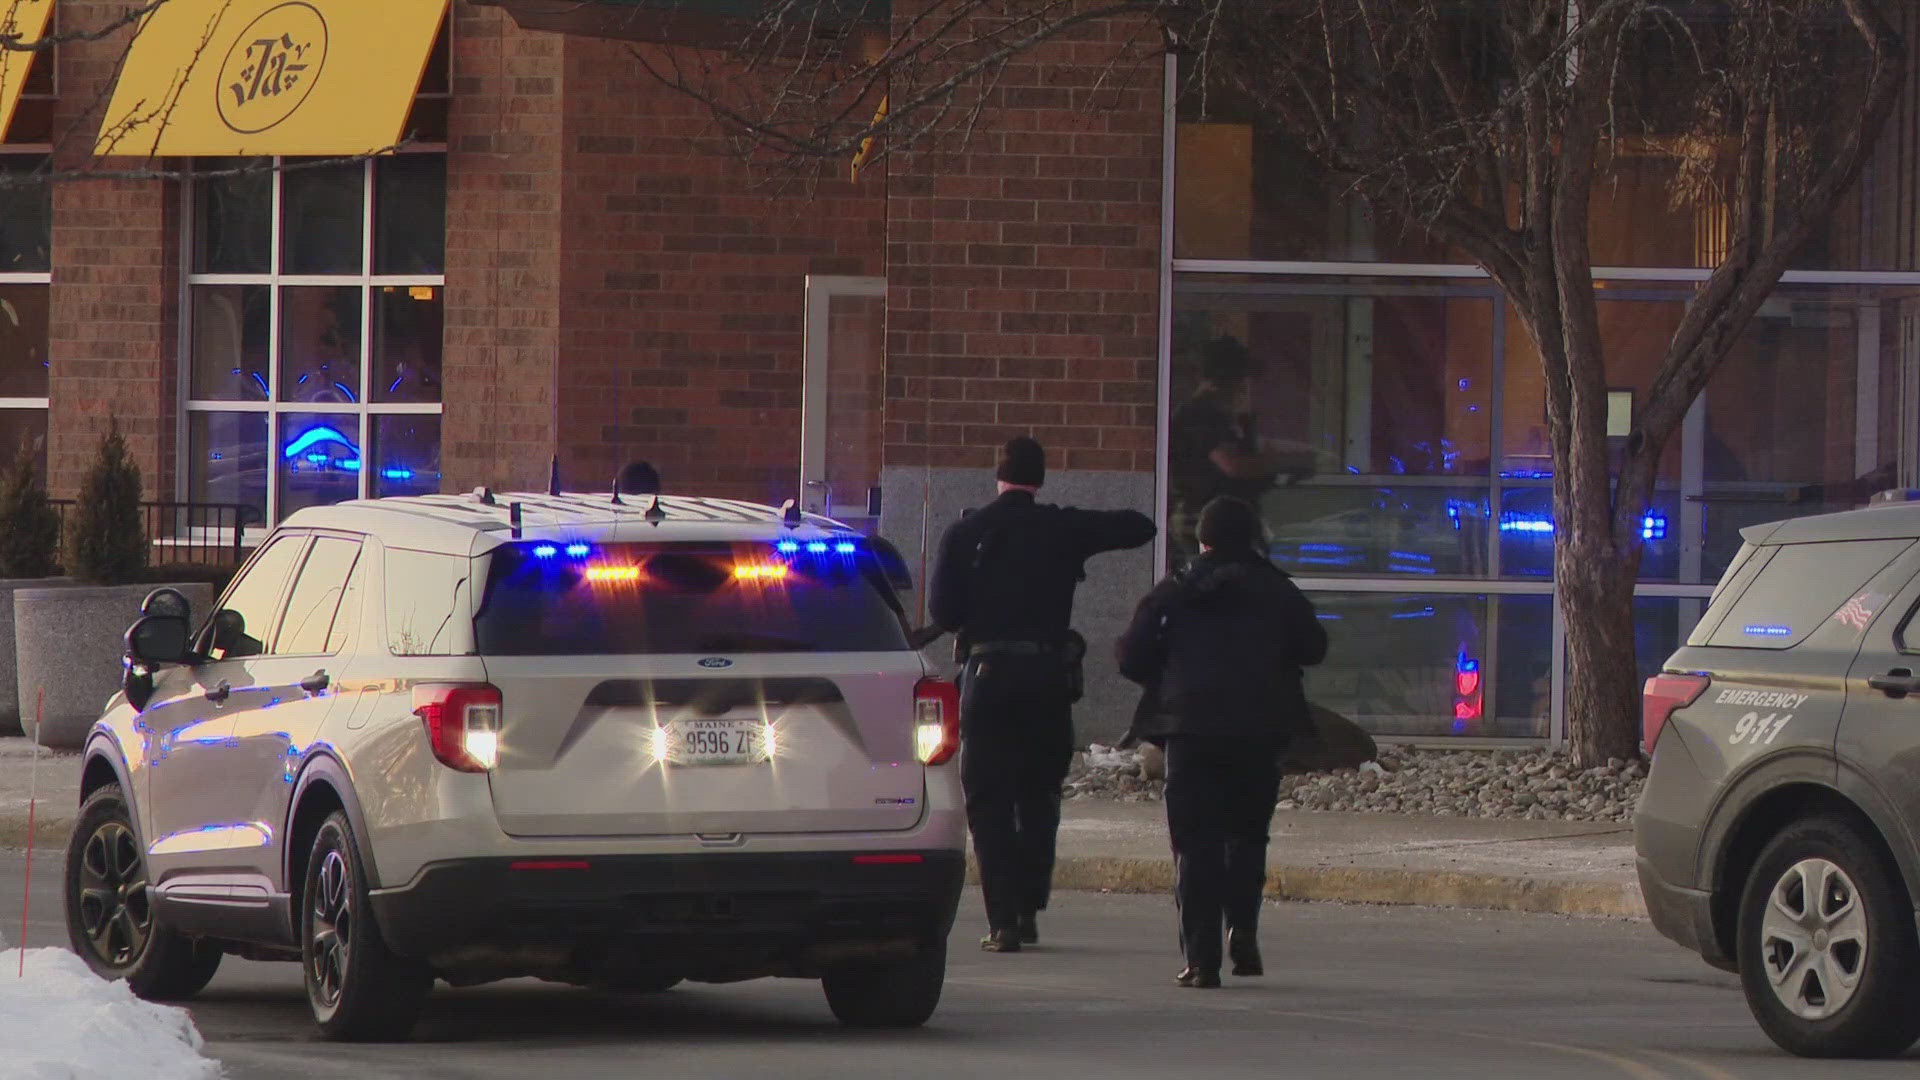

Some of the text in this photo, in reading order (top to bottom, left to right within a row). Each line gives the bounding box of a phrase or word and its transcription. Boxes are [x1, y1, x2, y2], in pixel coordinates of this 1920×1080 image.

[1715, 689, 1809, 709] EMERGENCY
[694, 721, 735, 729] MAINE
[686, 731, 729, 754] 9596
